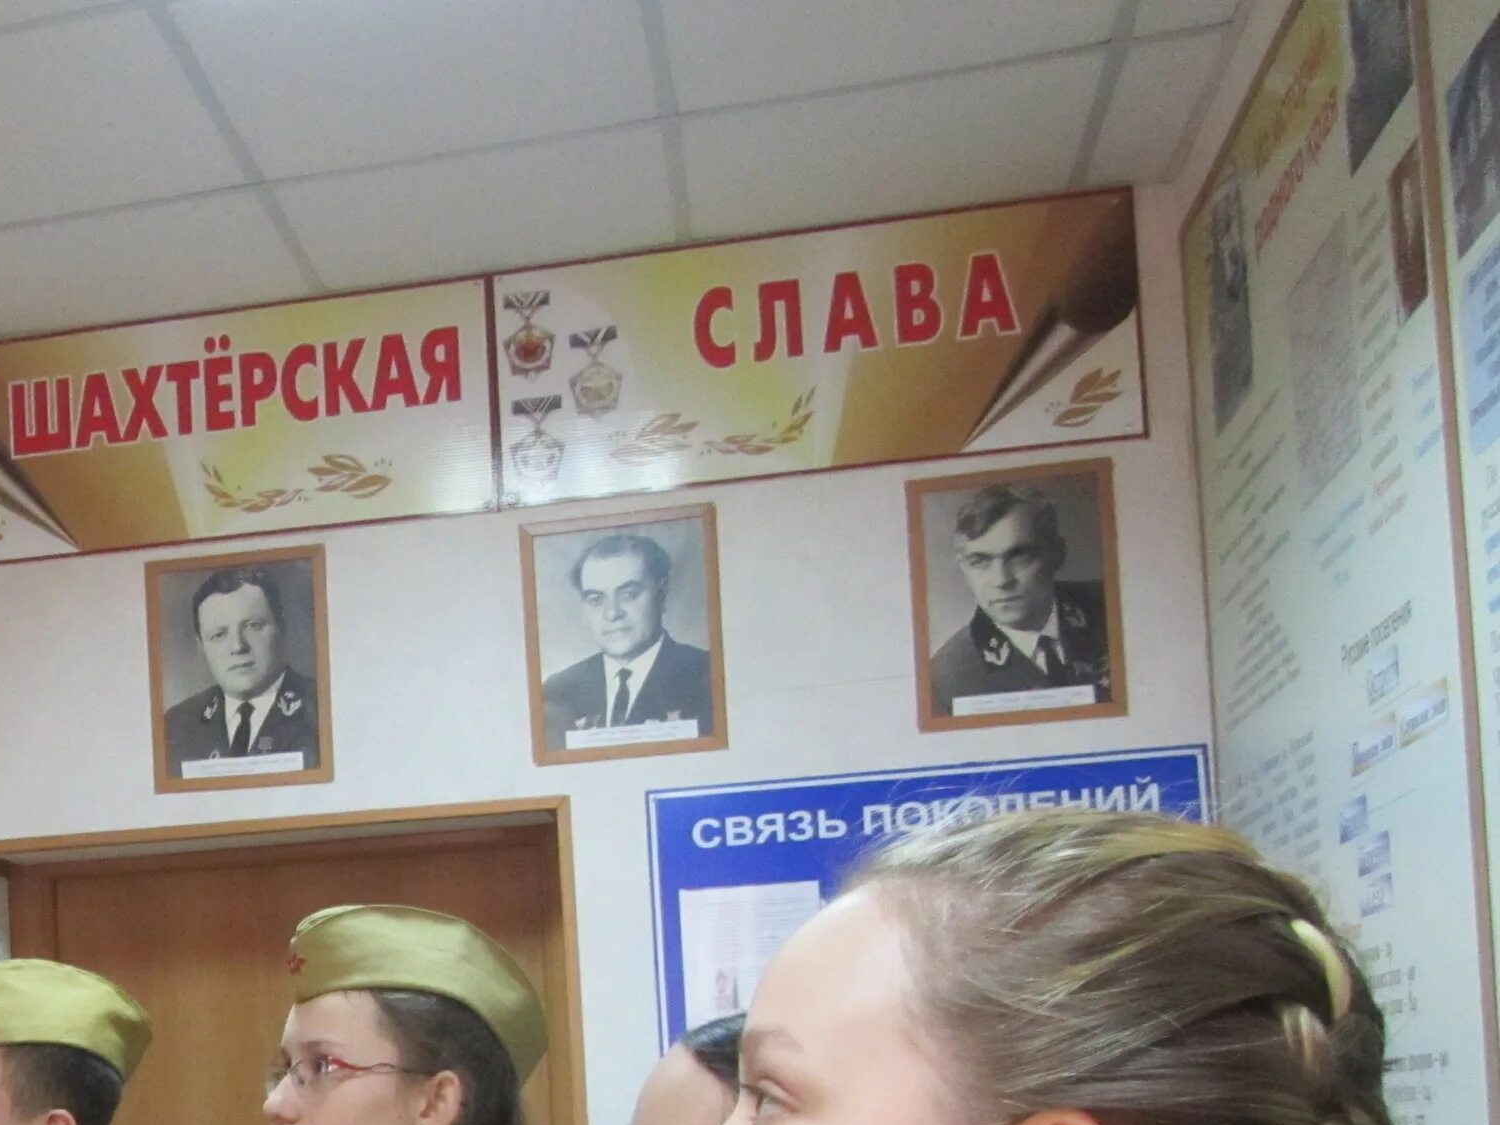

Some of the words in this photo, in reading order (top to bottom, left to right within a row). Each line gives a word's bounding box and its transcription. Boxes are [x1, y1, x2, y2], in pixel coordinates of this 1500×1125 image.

[694, 252, 1020, 368] СЛАВА
[11, 325, 462, 457] ШАХТЁРСКАЯ
[691, 807, 848, 850] СВЯЗЬ
